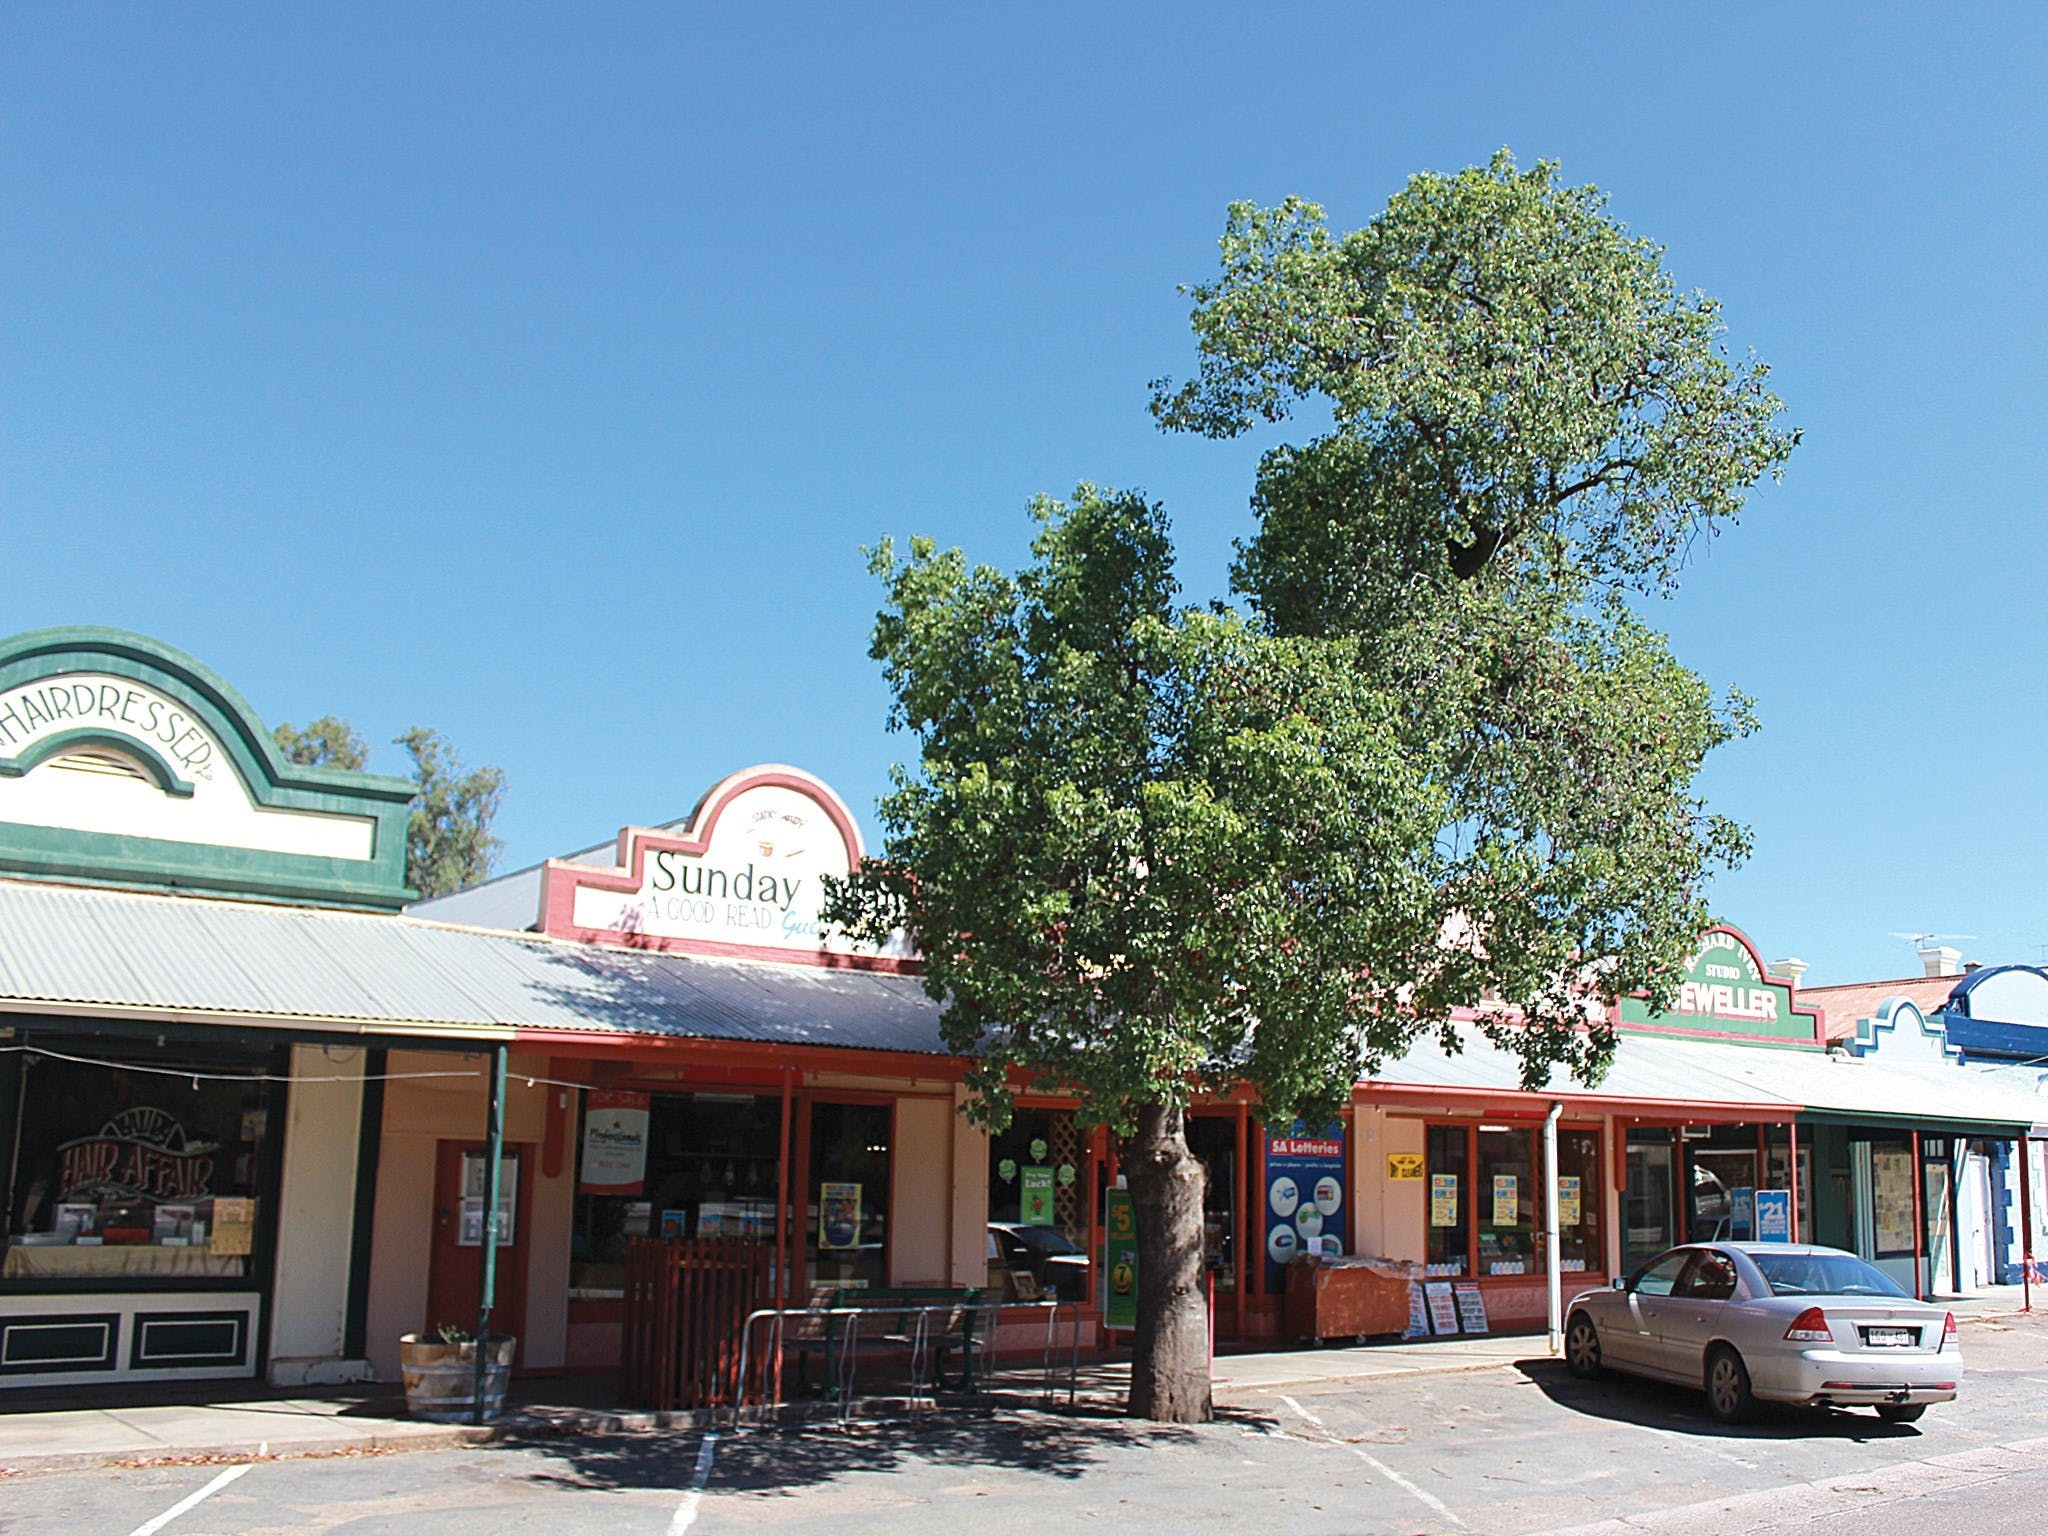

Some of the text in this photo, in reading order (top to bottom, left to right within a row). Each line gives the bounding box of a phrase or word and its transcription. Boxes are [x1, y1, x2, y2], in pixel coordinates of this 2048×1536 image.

[652, 850, 802, 912] Sunday
[667, 898, 715, 924] GOOD
[726, 903, 772, 930] READ
[1705, 963, 1740, 980] STUDIO
[1272, 1140, 1339, 1154] SA Lotteries
[60, 1142, 214, 1199] HAIR AFFAIR
